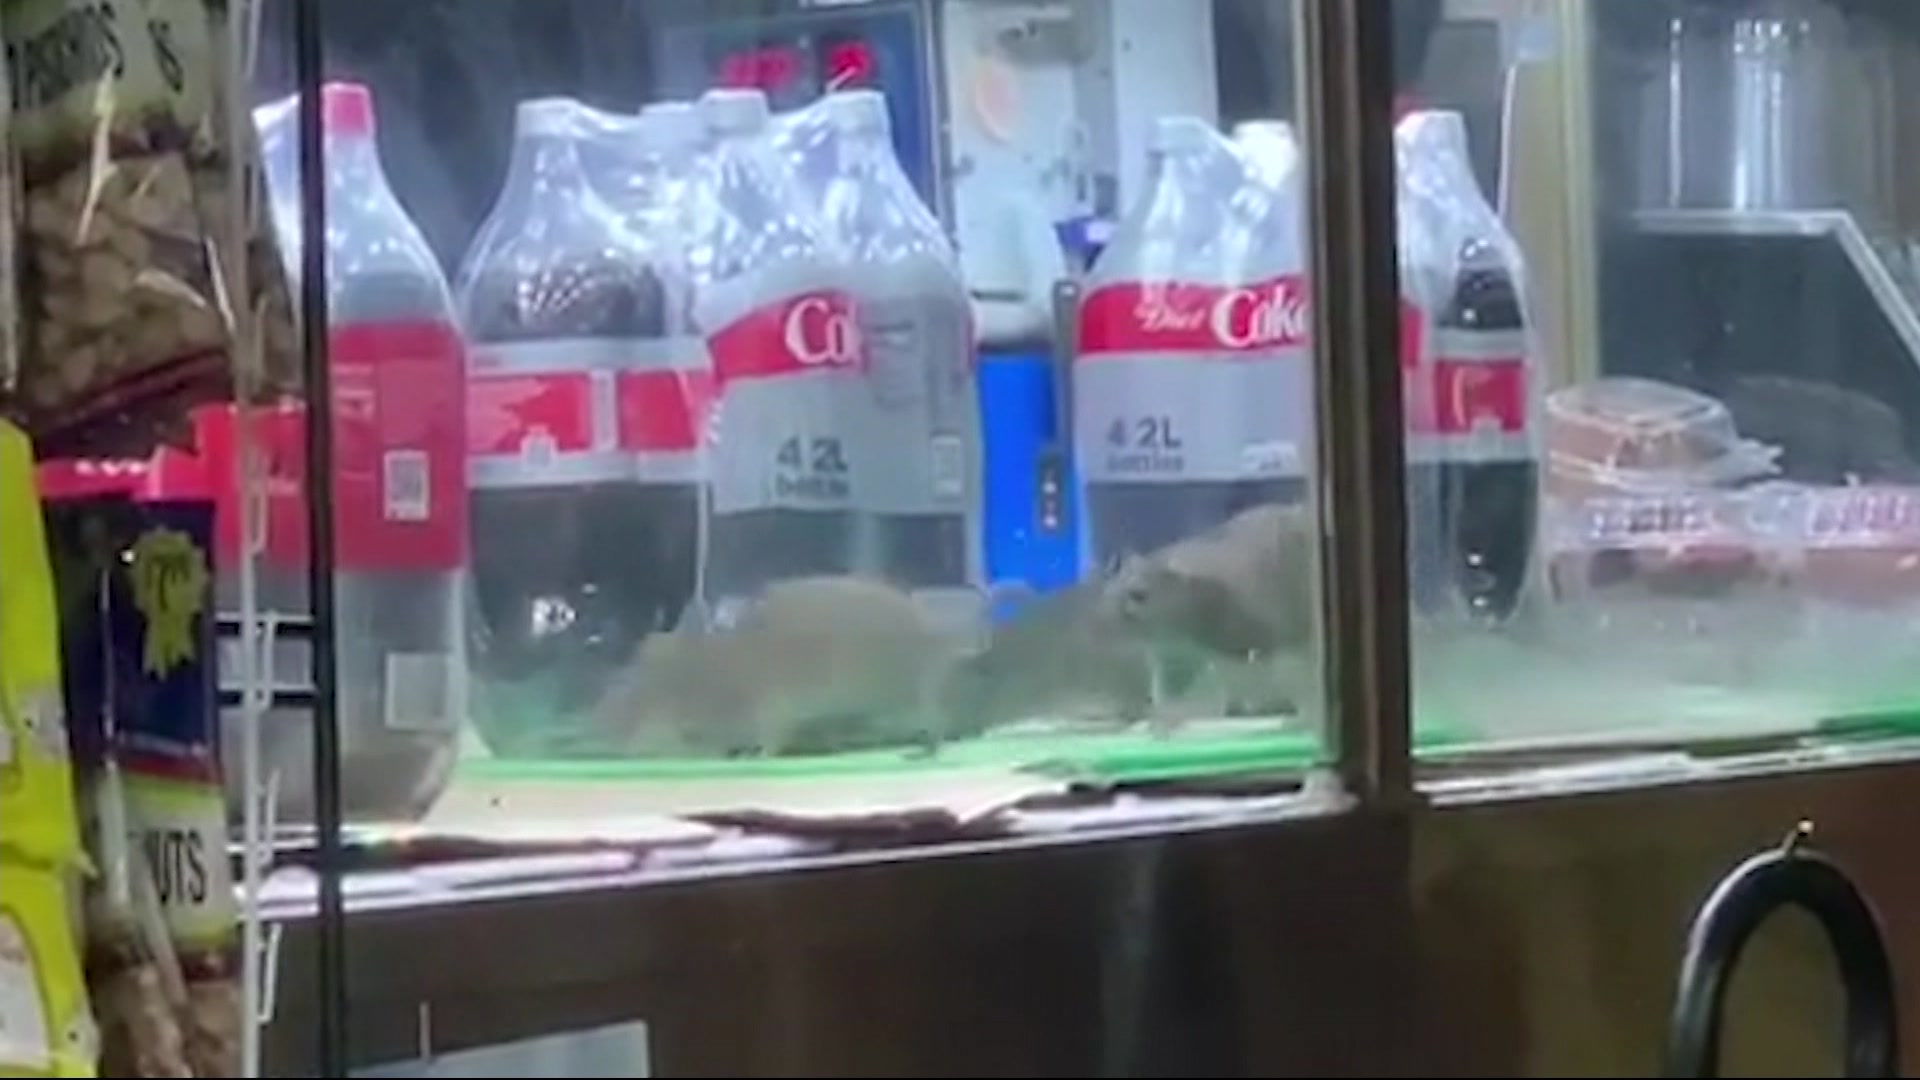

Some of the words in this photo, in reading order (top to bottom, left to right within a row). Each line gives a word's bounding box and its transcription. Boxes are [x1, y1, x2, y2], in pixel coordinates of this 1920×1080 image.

[1106, 418, 1127, 447] 4
[1136, 416, 1183, 449] 2L
[775, 437, 800, 467] 4
[811, 437, 849, 472] 2L
